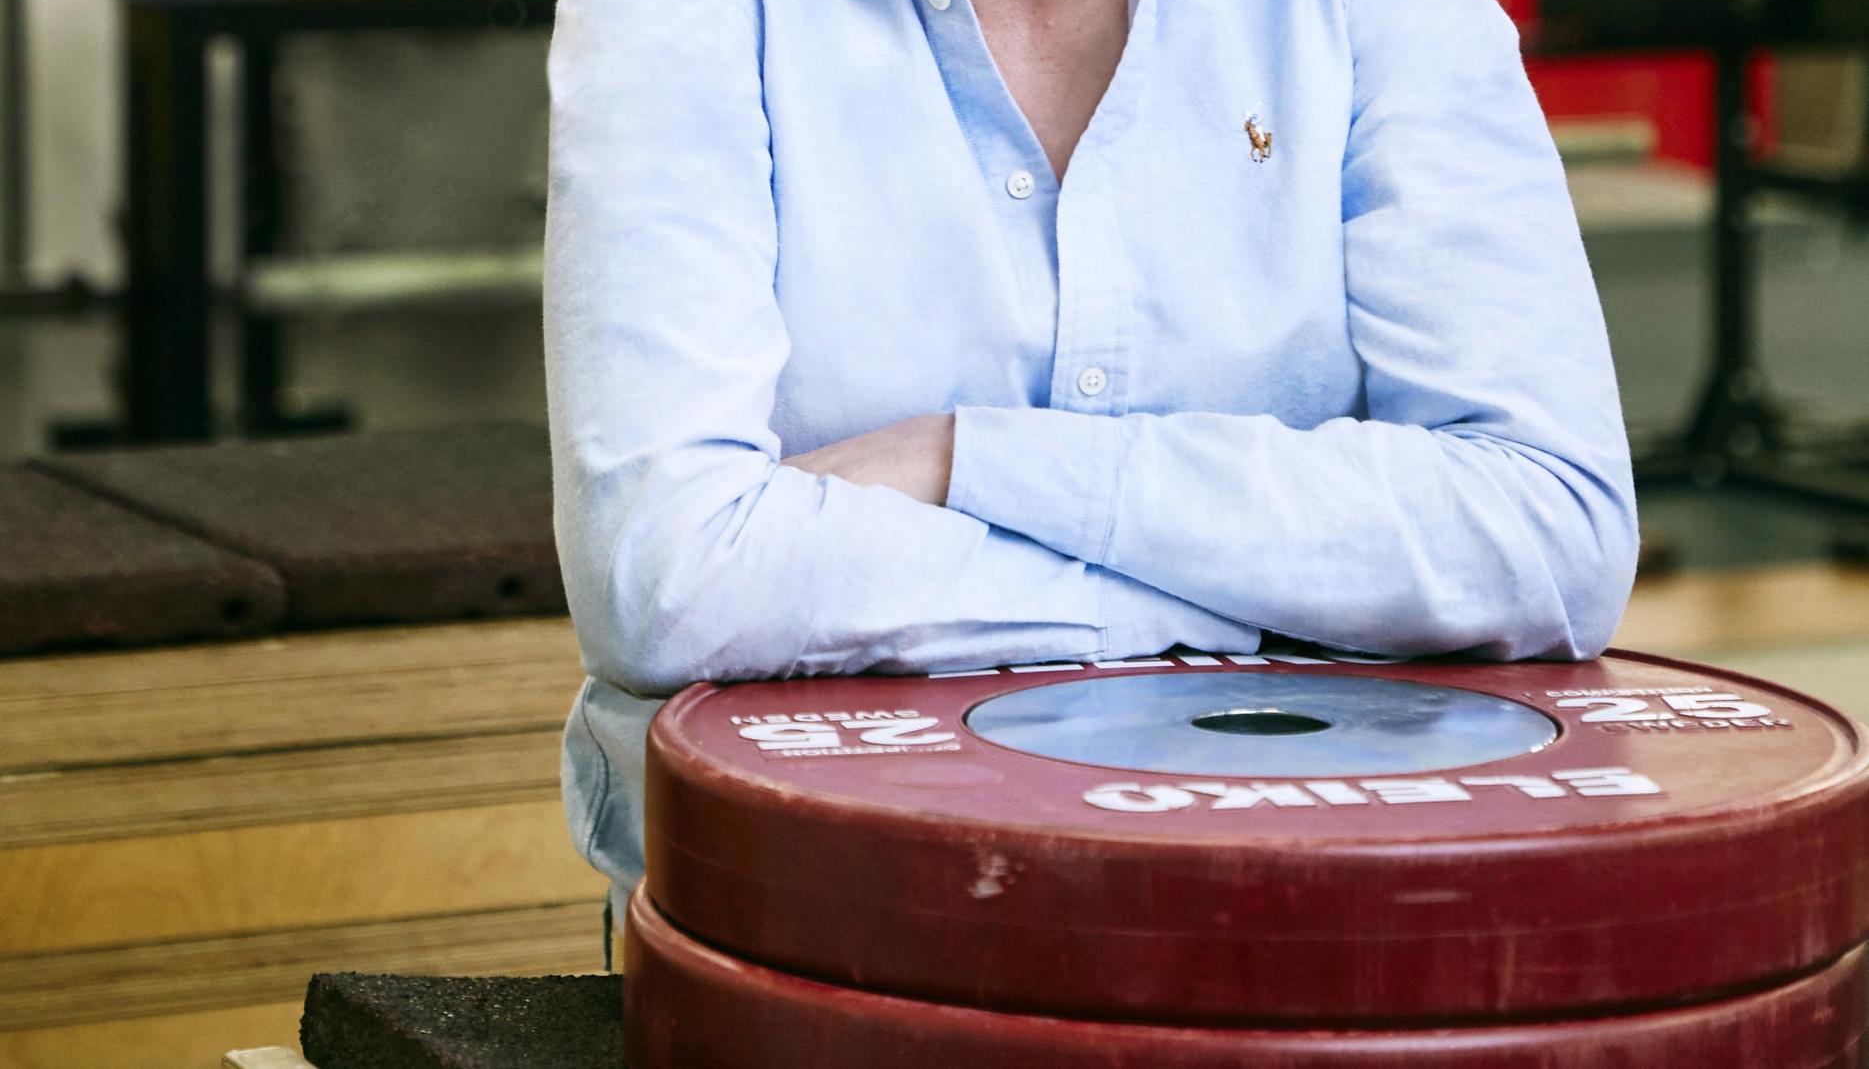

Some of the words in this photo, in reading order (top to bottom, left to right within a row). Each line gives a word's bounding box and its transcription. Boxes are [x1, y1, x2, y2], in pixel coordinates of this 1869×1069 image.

[729, 710, 919, 726] SWEDEN
[1555, 693, 1772, 723] 25
[738, 717, 956, 750] 25
[1083, 766, 1661, 813] ELEIKO
